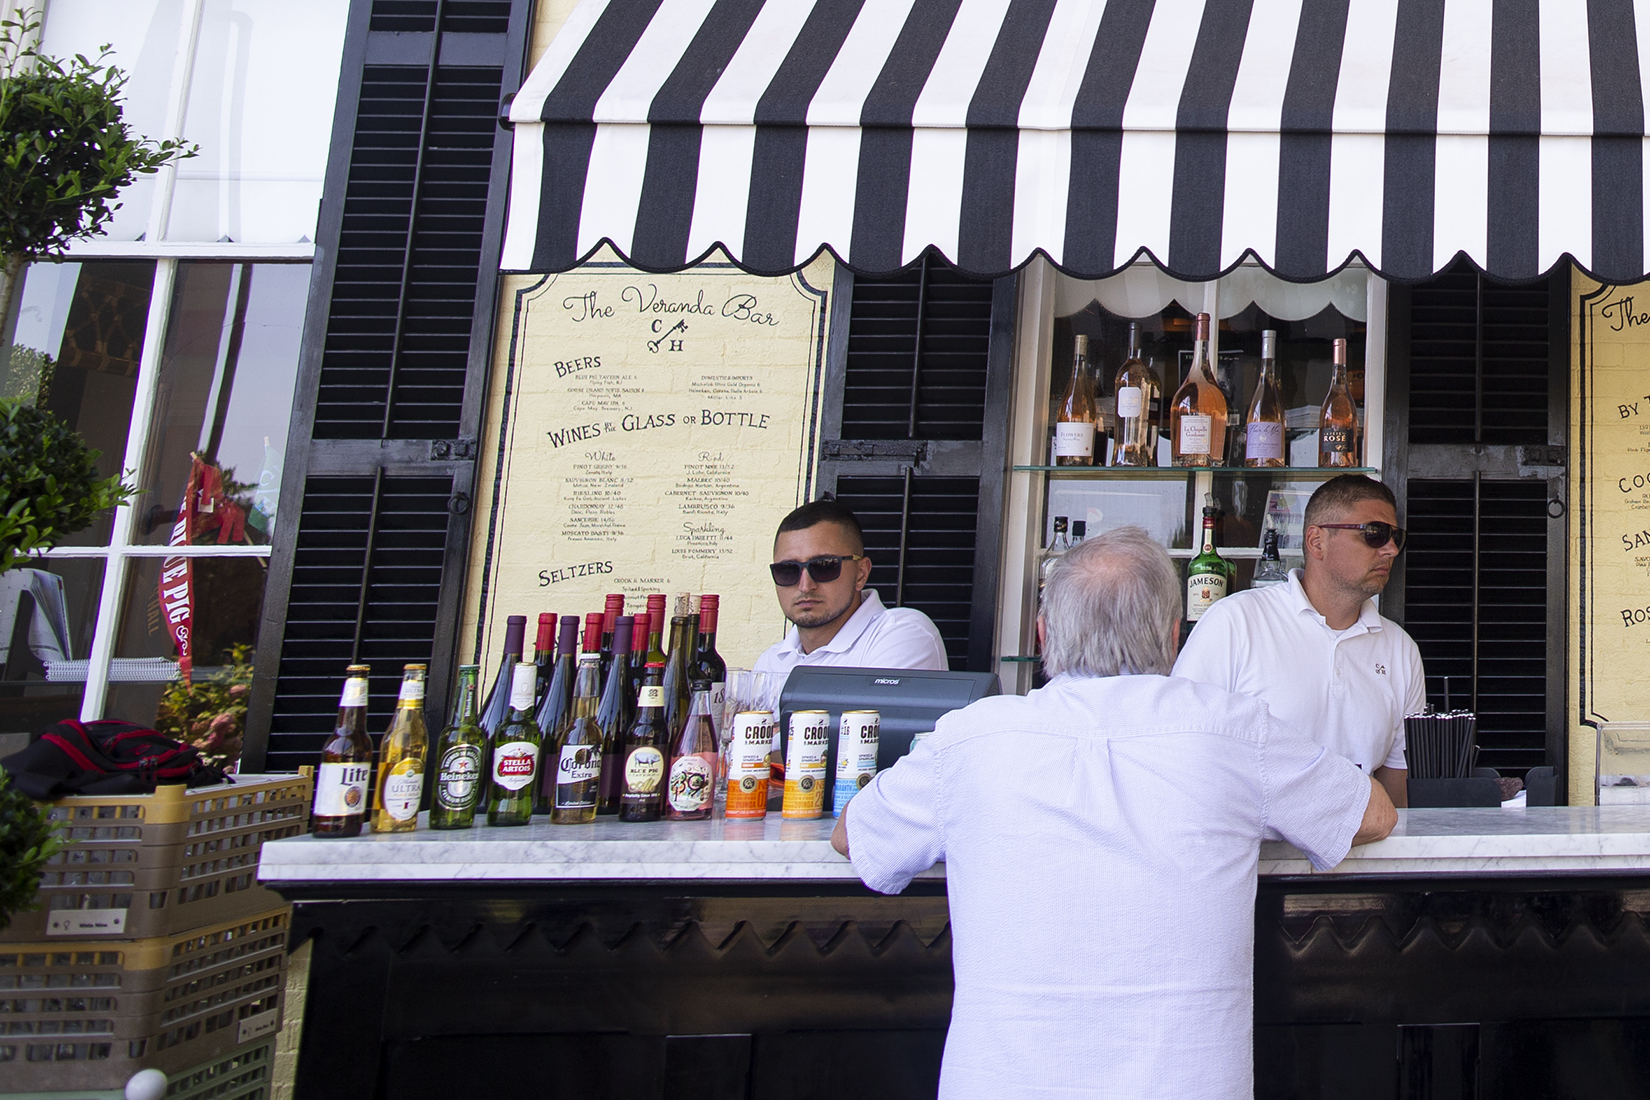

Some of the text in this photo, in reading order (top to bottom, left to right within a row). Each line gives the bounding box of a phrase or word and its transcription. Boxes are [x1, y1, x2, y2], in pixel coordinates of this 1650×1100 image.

[563, 283, 780, 327] The Veranda Bar
[1601, 296, 1650, 332] The
[651, 319, 663, 333] C
[668, 340, 684, 352] H
[553, 356, 602, 379] BEERS
[1617, 403, 1639, 420] BY
[546, 423, 601, 449] WINES
[621, 413, 676, 432] GLASS
[683, 416, 697, 425] OR
[700, 409, 771, 430] BOTTLE
[584, 450, 617, 462] White
[698, 451, 725, 462] Red
[683, 522, 725, 536] Sparkling
[538, 560, 614, 588] SELTZERS
[1189, 577, 1224, 588] JAMESON
[163, 580, 190, 624] PIG
[874, 677, 900, 686] micros
[745, 725, 774, 740] CROO
[803, 726, 830, 740] CROO
[501, 765, 531, 773] ARTOIS
[503, 758, 532, 766] STELLA
[340, 768, 369, 786] Lite
